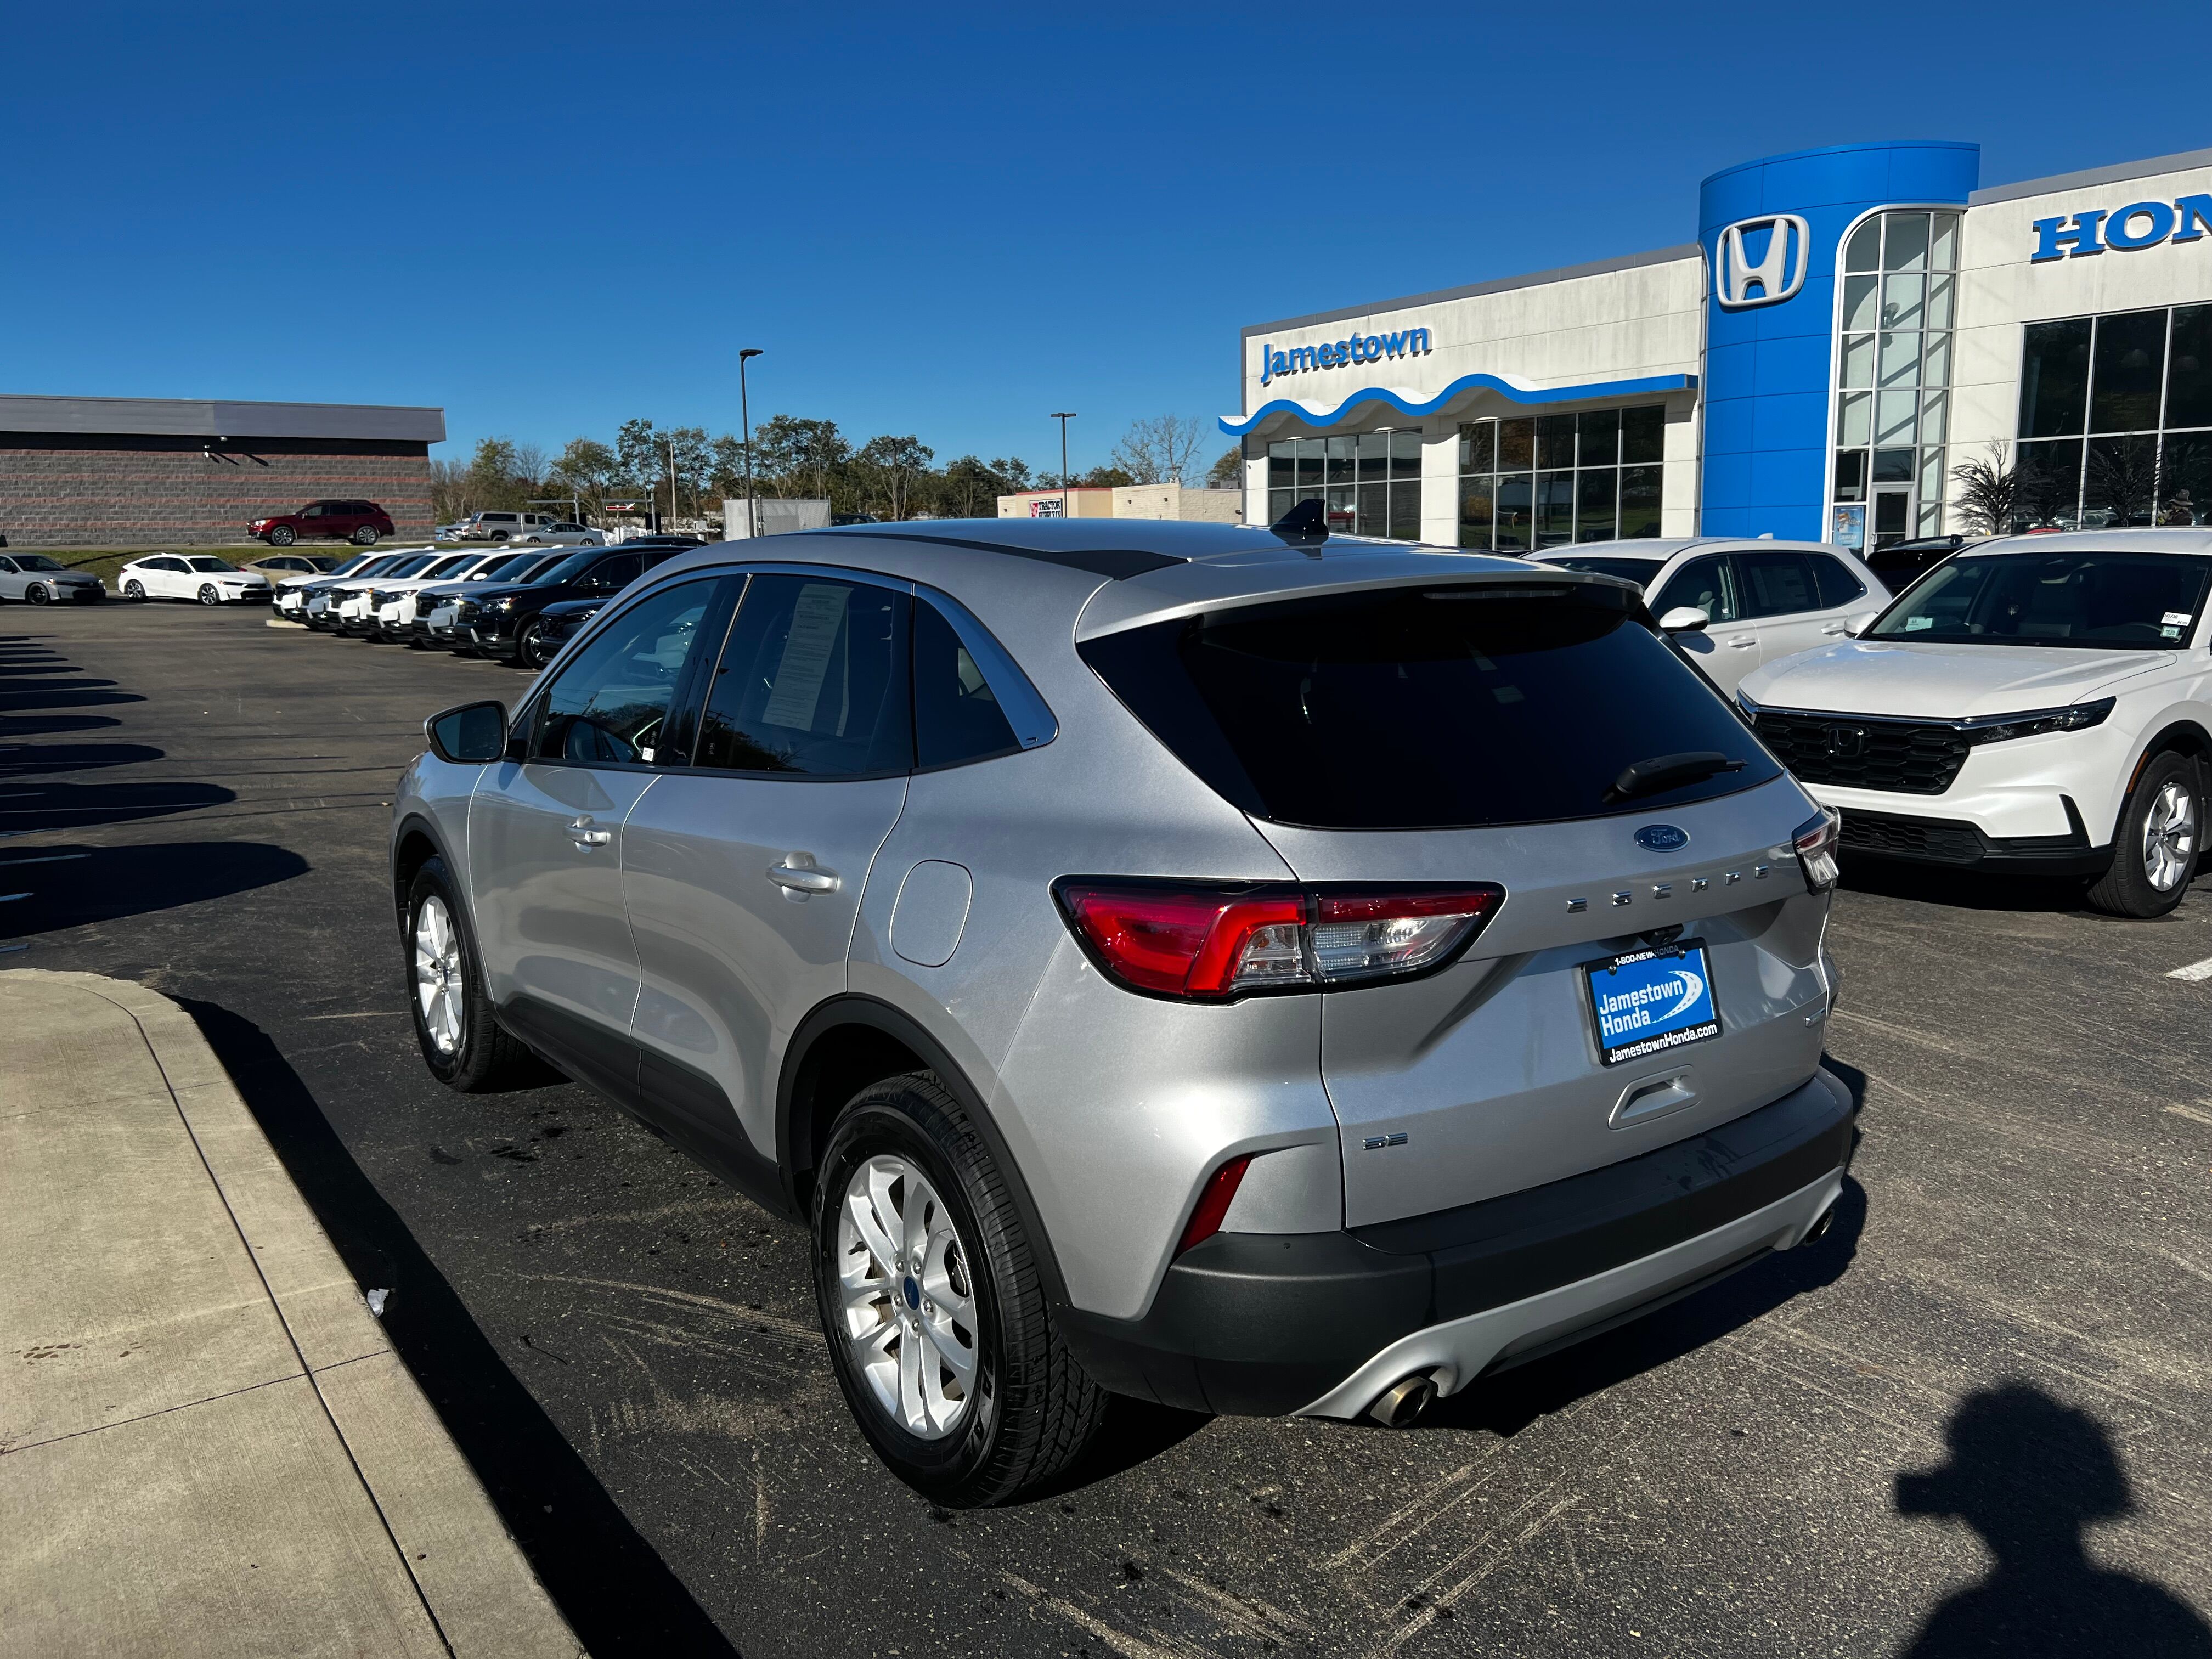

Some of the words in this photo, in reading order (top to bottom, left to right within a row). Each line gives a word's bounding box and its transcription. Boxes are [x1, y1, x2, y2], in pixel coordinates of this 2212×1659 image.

[1260, 327, 1431, 383] Jamestown
[1038, 500, 1060, 511] TRACTOR
[1650, 828, 1680, 845] Ford
[1567, 865, 1769, 913] ESCAPE
[1615, 945, 1679, 966] 1-800-NEW-HONDA
[1599, 979, 1684, 1015] Jamestown
[1601, 1007, 1651, 1037] Honda
[1610, 1024, 1717, 1063] JamestownHonda.com
